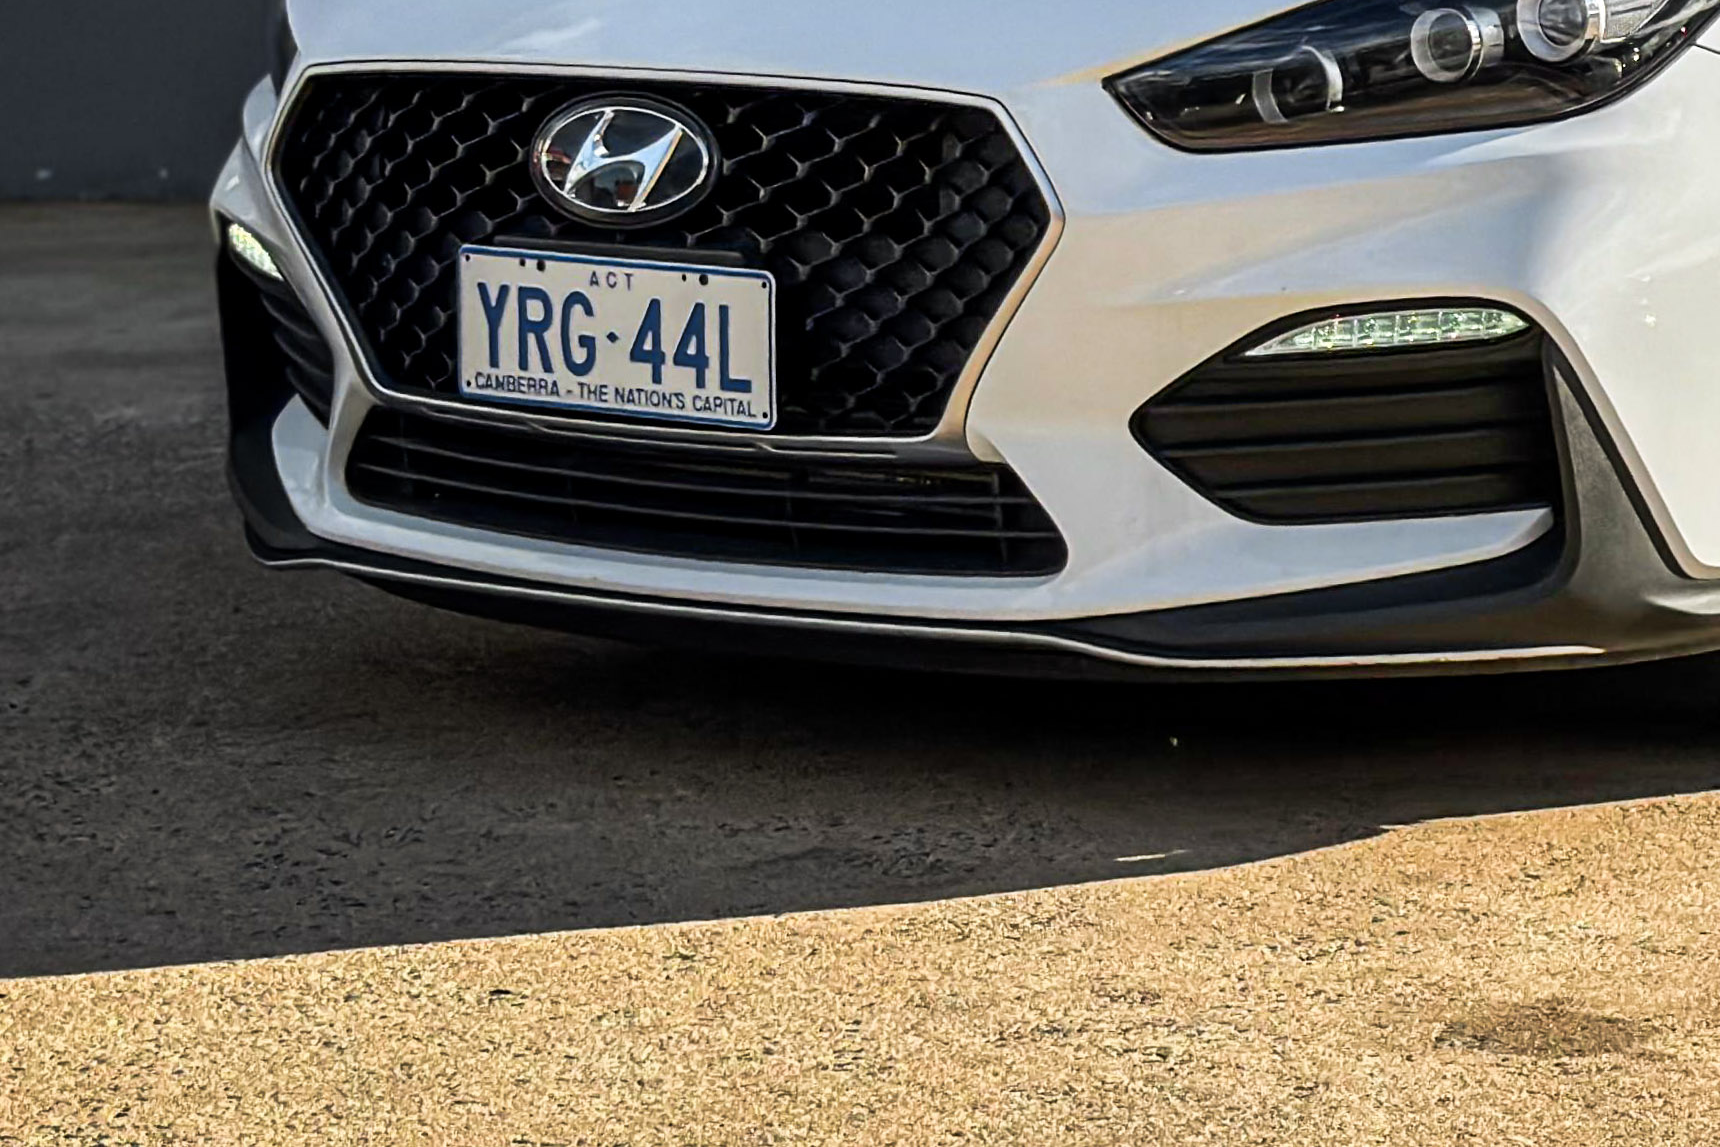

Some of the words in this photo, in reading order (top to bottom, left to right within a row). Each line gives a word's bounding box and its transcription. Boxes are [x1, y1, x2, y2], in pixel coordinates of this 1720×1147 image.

[589, 270, 634, 291] ACT
[475, 372, 561, 397] CANBERRA
[578, 382, 608, 403] THE
[614, 387, 685, 410] NATION'S
[692, 395, 757, 418] CAPITAL
